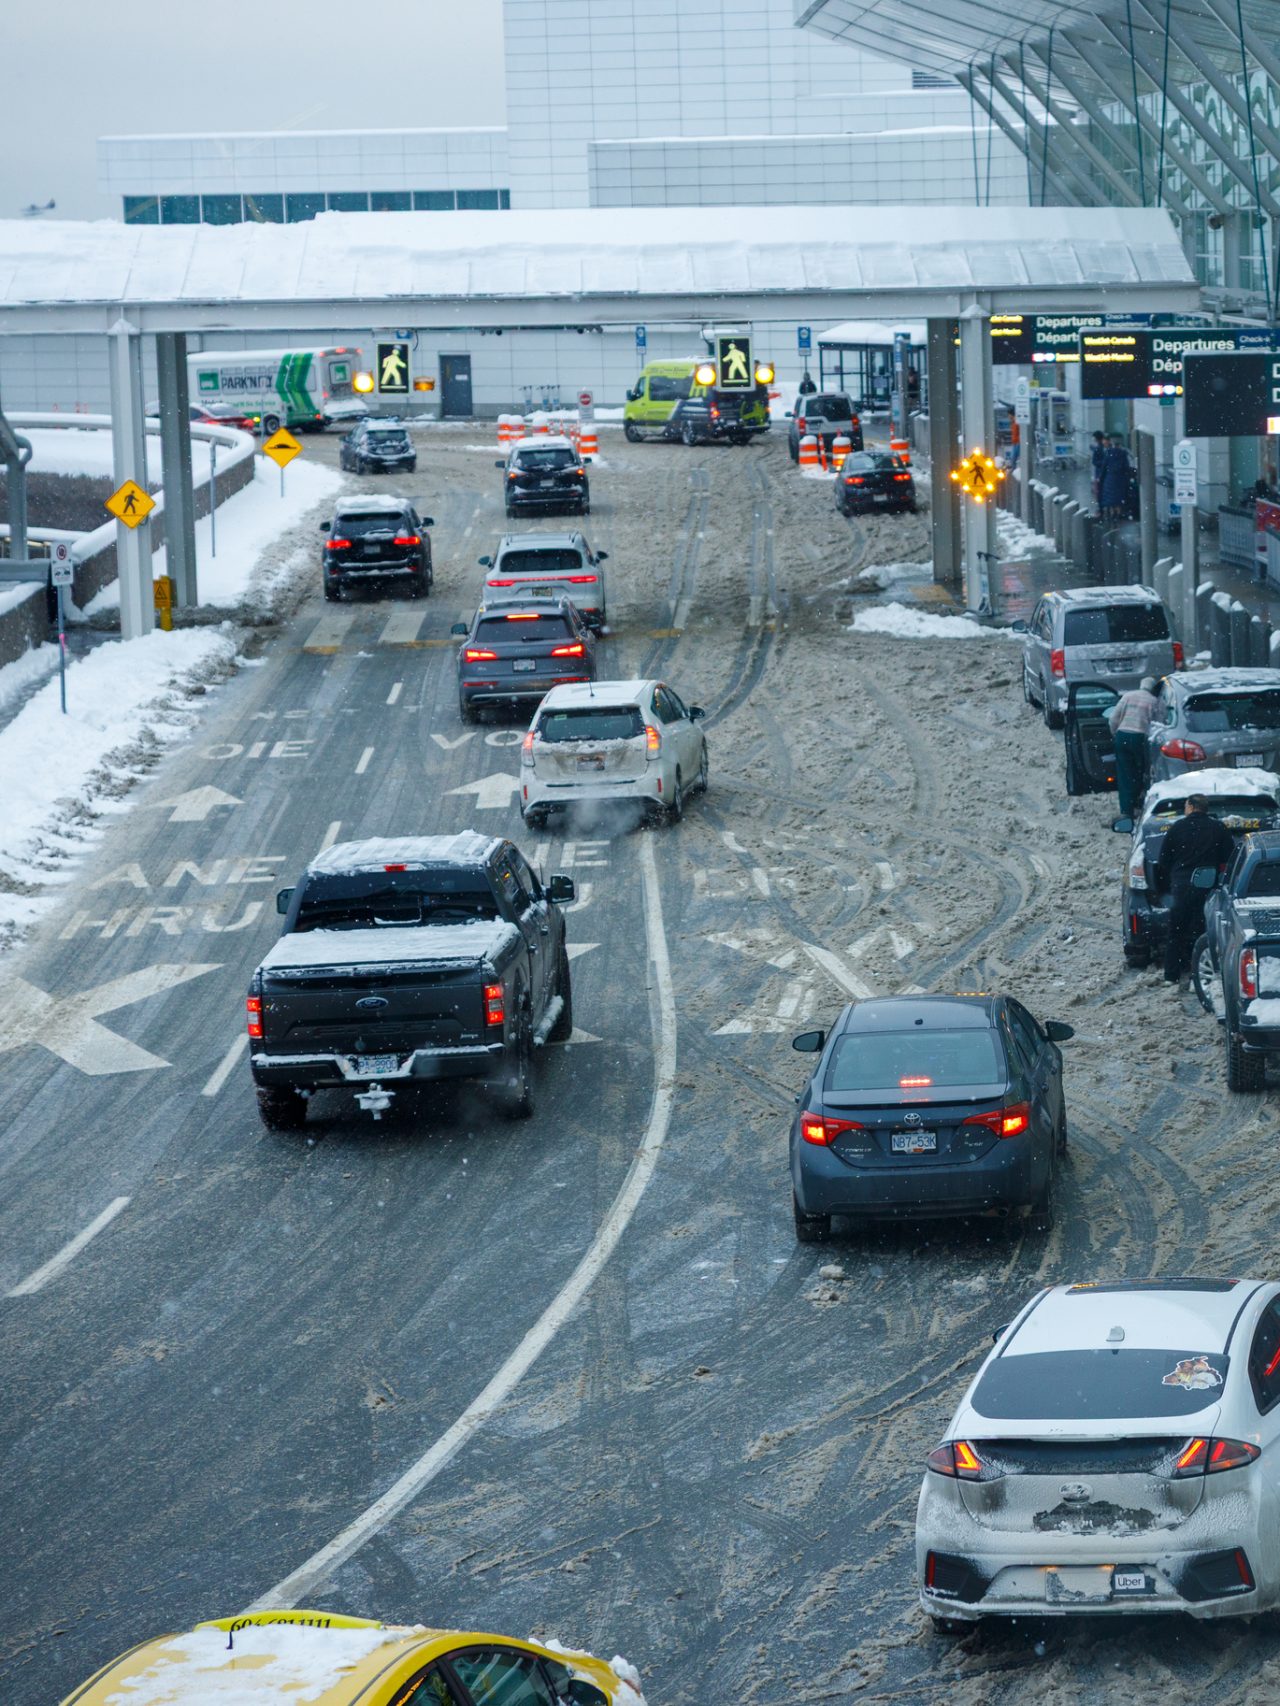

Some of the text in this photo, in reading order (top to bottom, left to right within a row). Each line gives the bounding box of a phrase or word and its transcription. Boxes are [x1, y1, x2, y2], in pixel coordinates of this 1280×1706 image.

[1036, 316, 1102, 329] Departures
[1035, 331, 1080, 345] Départ
[1153, 339, 1235, 354] Departures
[1118, 1577, 1142, 1587] Uber
